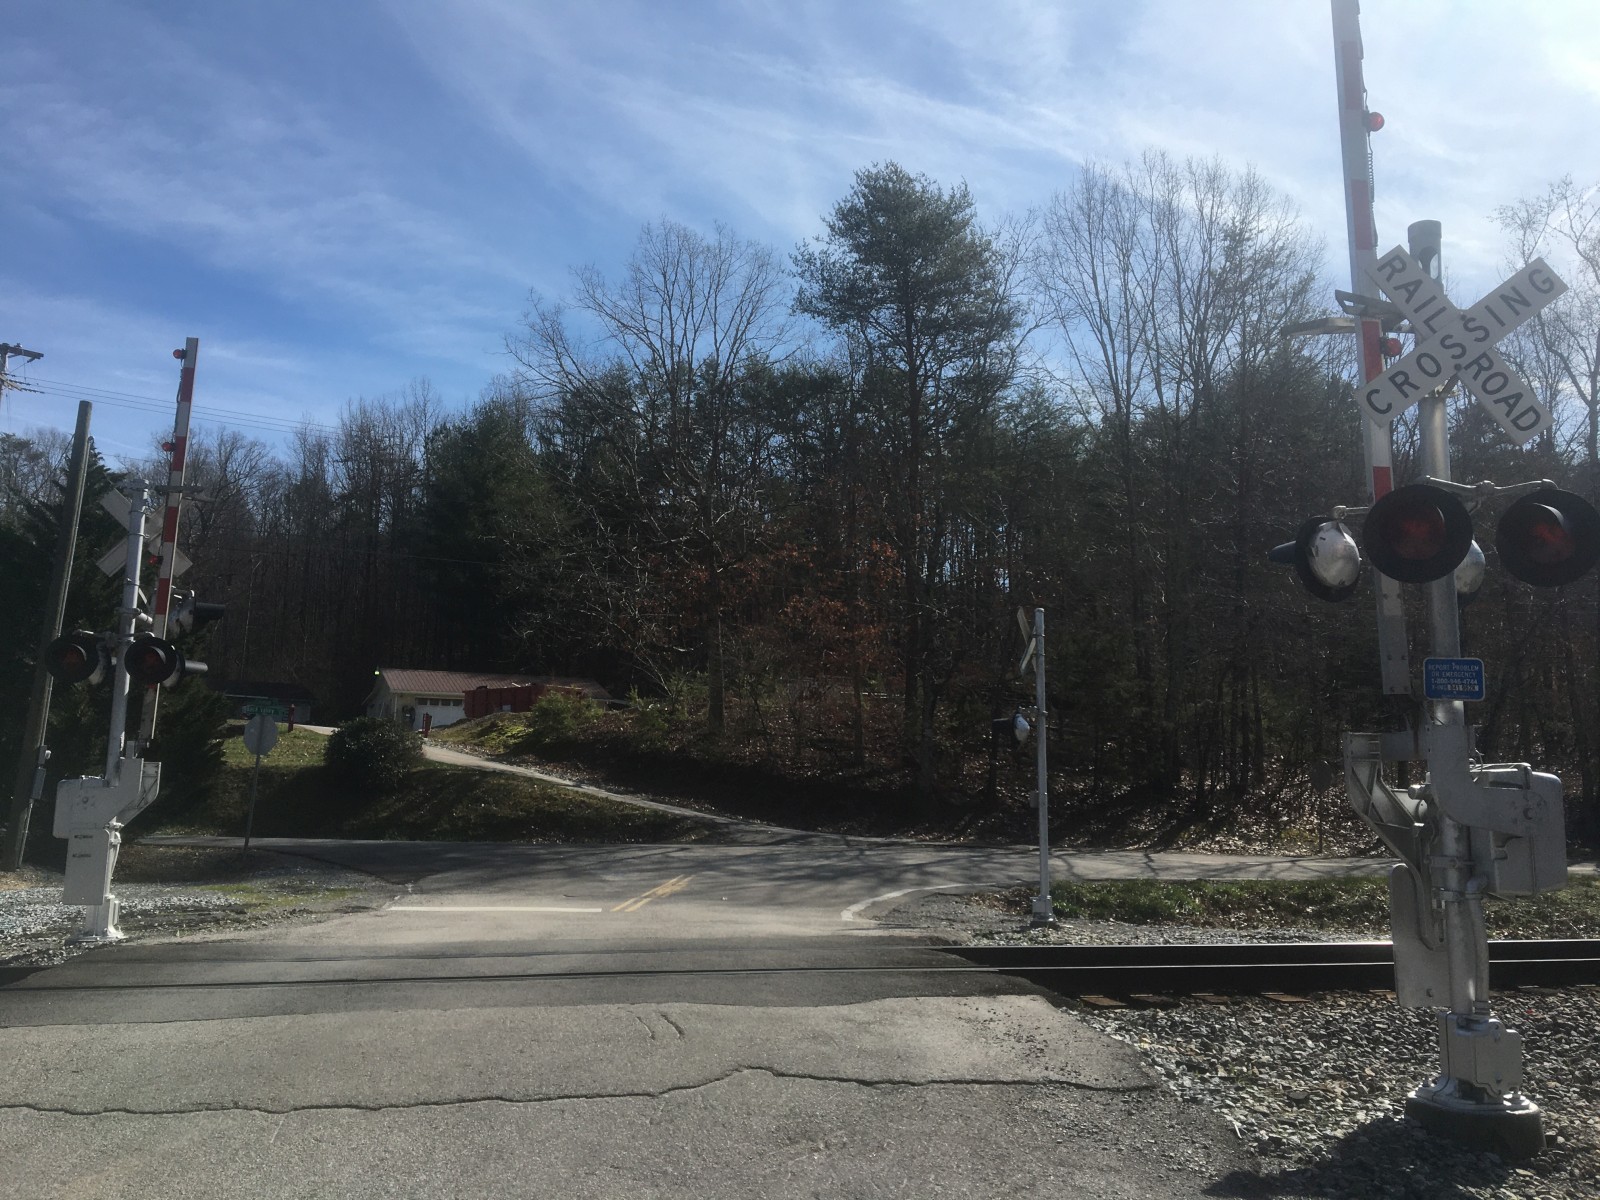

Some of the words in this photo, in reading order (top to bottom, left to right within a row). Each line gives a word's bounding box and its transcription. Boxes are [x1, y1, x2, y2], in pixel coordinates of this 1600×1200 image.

[1366, 268, 1554, 415] CROSSING
[1377, 255, 1447, 334] RAIL
[1464, 353, 1541, 432] ROAD
[1453, 664, 1479, 672] PROBLEM
